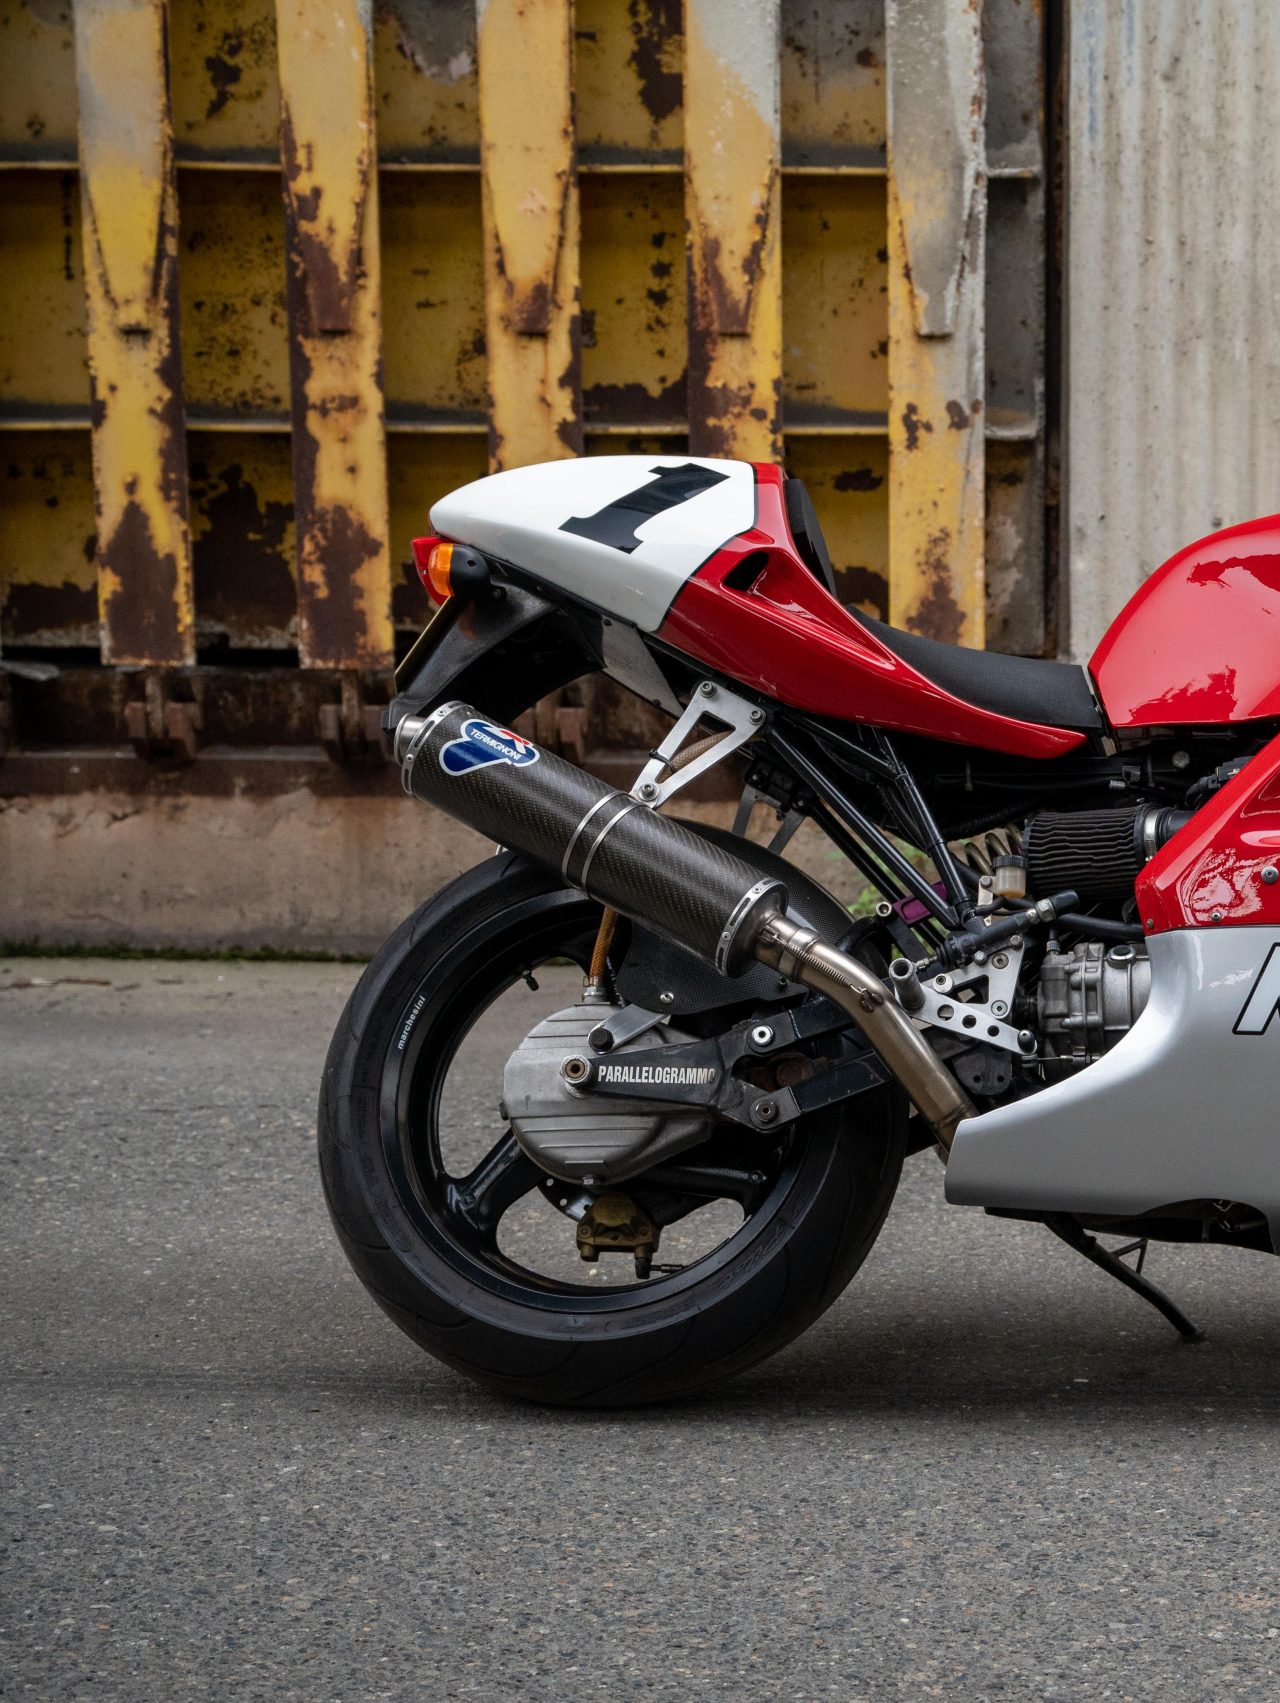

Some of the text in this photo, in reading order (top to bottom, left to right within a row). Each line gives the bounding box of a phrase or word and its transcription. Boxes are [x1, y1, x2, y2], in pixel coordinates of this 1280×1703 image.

[558, 463, 730, 555] 1
[470, 728, 522, 760] TERMIGNONI
[397, 994, 426, 1050] marchesini
[598, 1065, 716, 1085] PARALLELOGRAMMO
